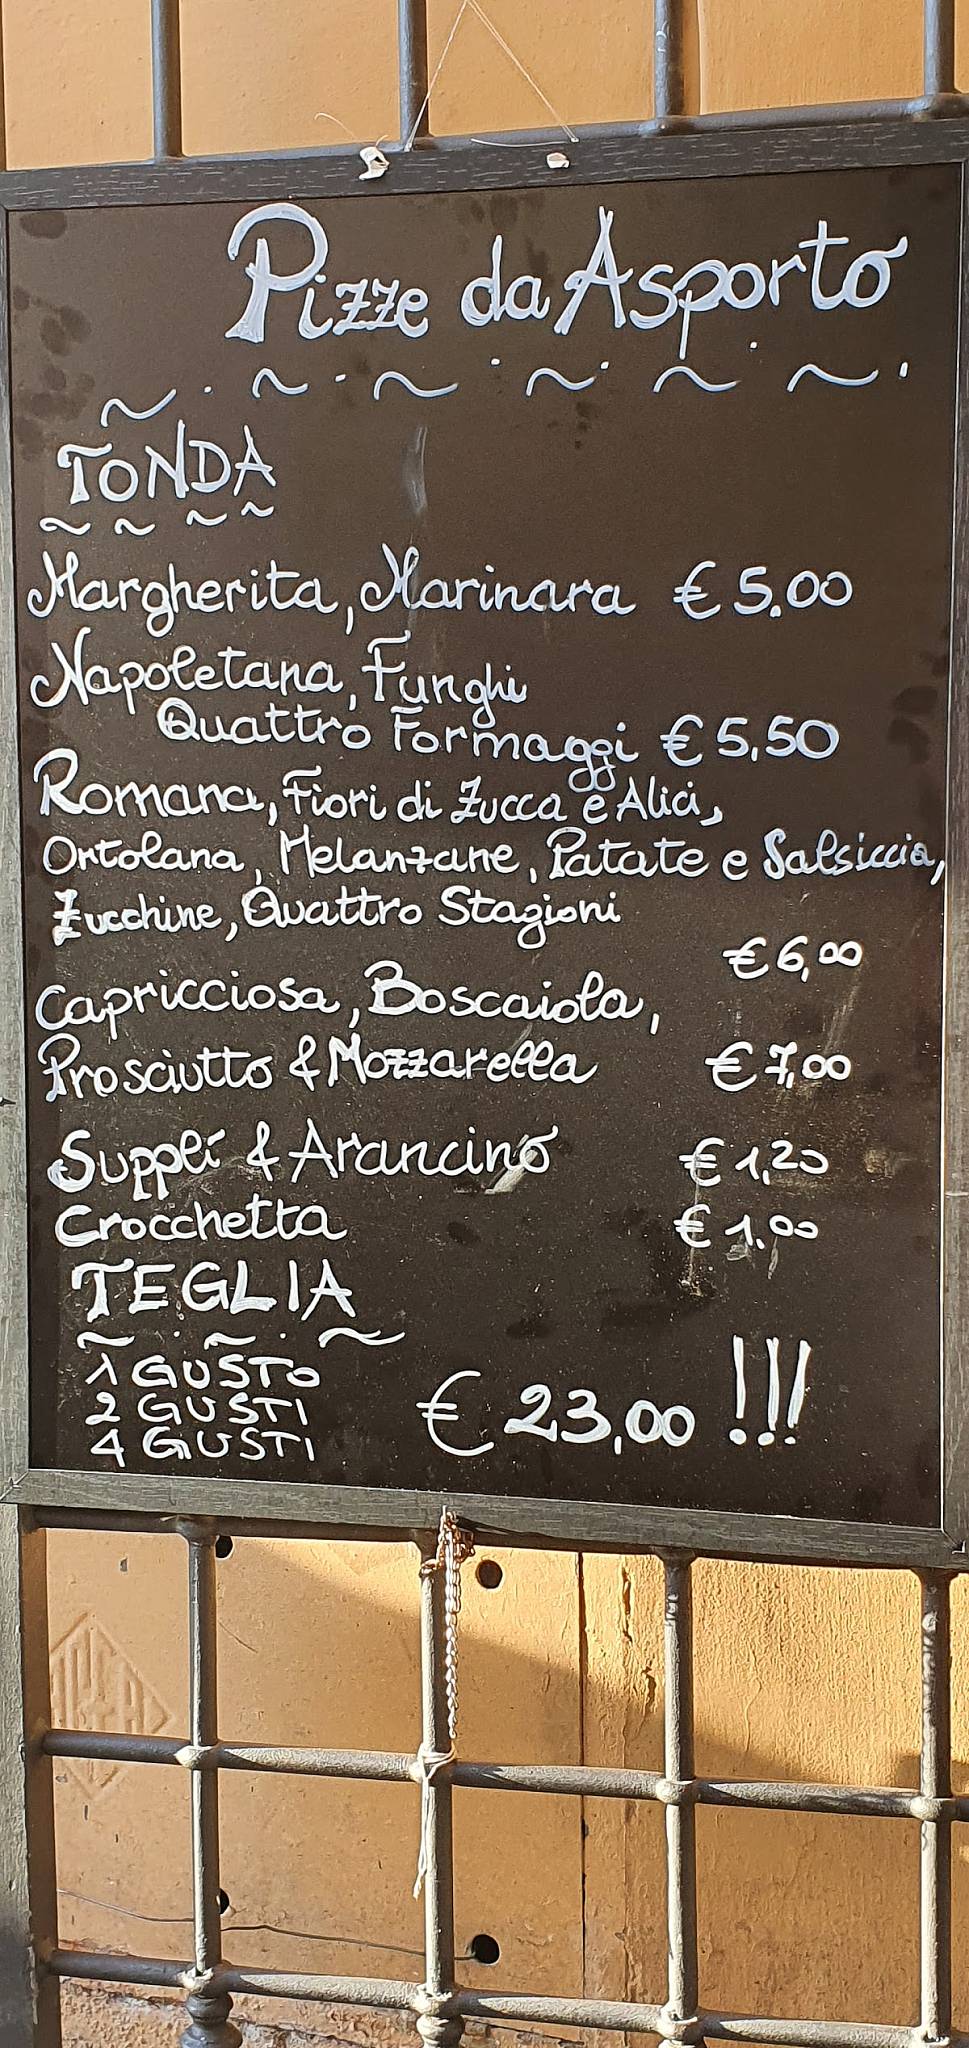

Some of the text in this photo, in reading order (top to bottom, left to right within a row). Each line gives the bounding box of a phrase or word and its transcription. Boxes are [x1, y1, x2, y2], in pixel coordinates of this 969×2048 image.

[225, 202, 909, 359] Pizze da Asporto
[57, 420, 276, 505] TONDA
[27, 549, 354, 637] Margherita,
[359, 543, 637, 615] Marinara
[30, 627, 528, 729] Napoletana, Funghi
[156, 697, 372, 750] Quattro
[390, 704, 640, 792] Formaggi
[32, 748, 724, 826] Romana, Fiori di Zucca e Alici,
[42, 824, 947, 886] Ortolana, Melanzane, Patate e Salsiccia,
[51, 884, 622, 950] Zucchine, Quattro Stagioni
[35, 960, 661, 1040] Capricciosa, Boscaiola,
[37, 1032, 274, 1103] Prosciutto
[289, 1034, 325, 1091] &
[327, 1032, 599, 1088] Mozzarella
[246, 1120, 281, 1182] &
[287, 1117, 560, 1184] Arancino
[54, 1193, 349, 1248] Crocchetta
[71, 1258, 357, 1323] TEGLIA
[85, 1353, 321, 1389] 1 GUSTO
[728, 1334, 812, 1446] !!!
[85, 1392, 308, 1426] 2 GUSTI
[90, 1426, 316, 1468] 4 GUSTI
